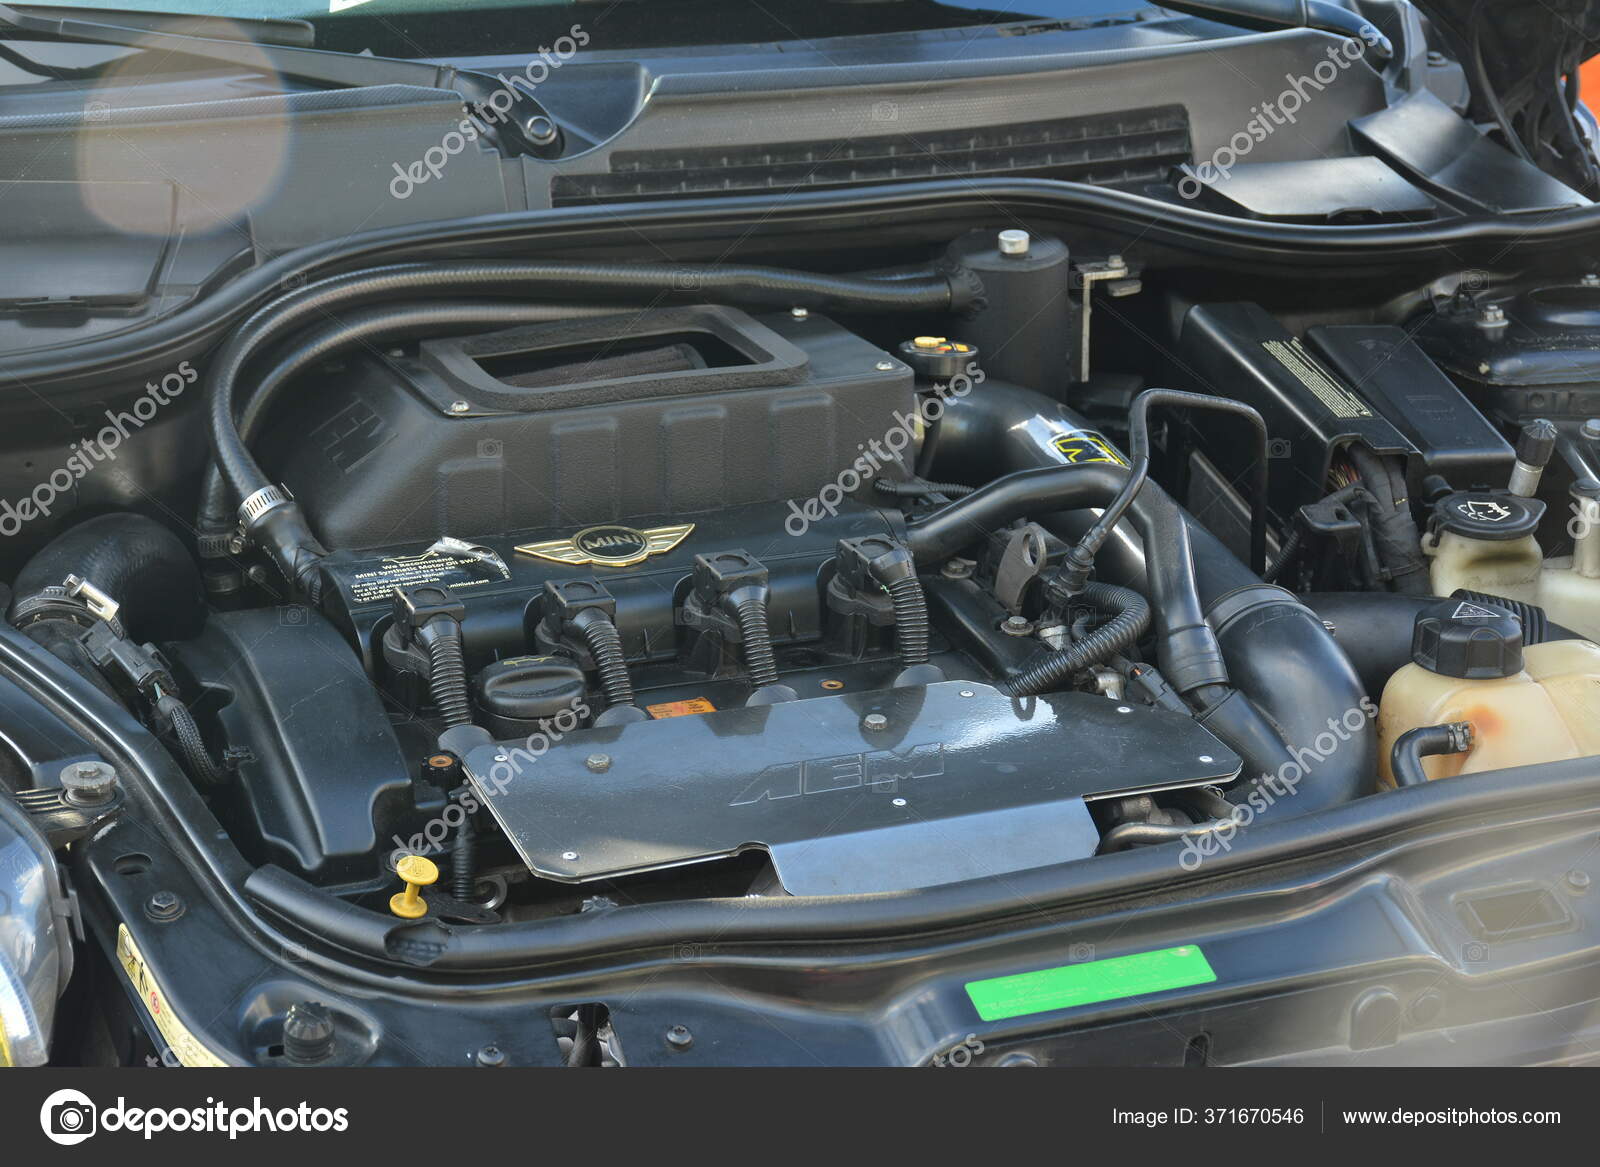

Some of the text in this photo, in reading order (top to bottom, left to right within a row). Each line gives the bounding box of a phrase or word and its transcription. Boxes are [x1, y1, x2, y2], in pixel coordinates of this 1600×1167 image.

[583, 534, 641, 550] MINI
[418, 561, 444, 570] Motor
[729, 742, 944, 807] AEM
